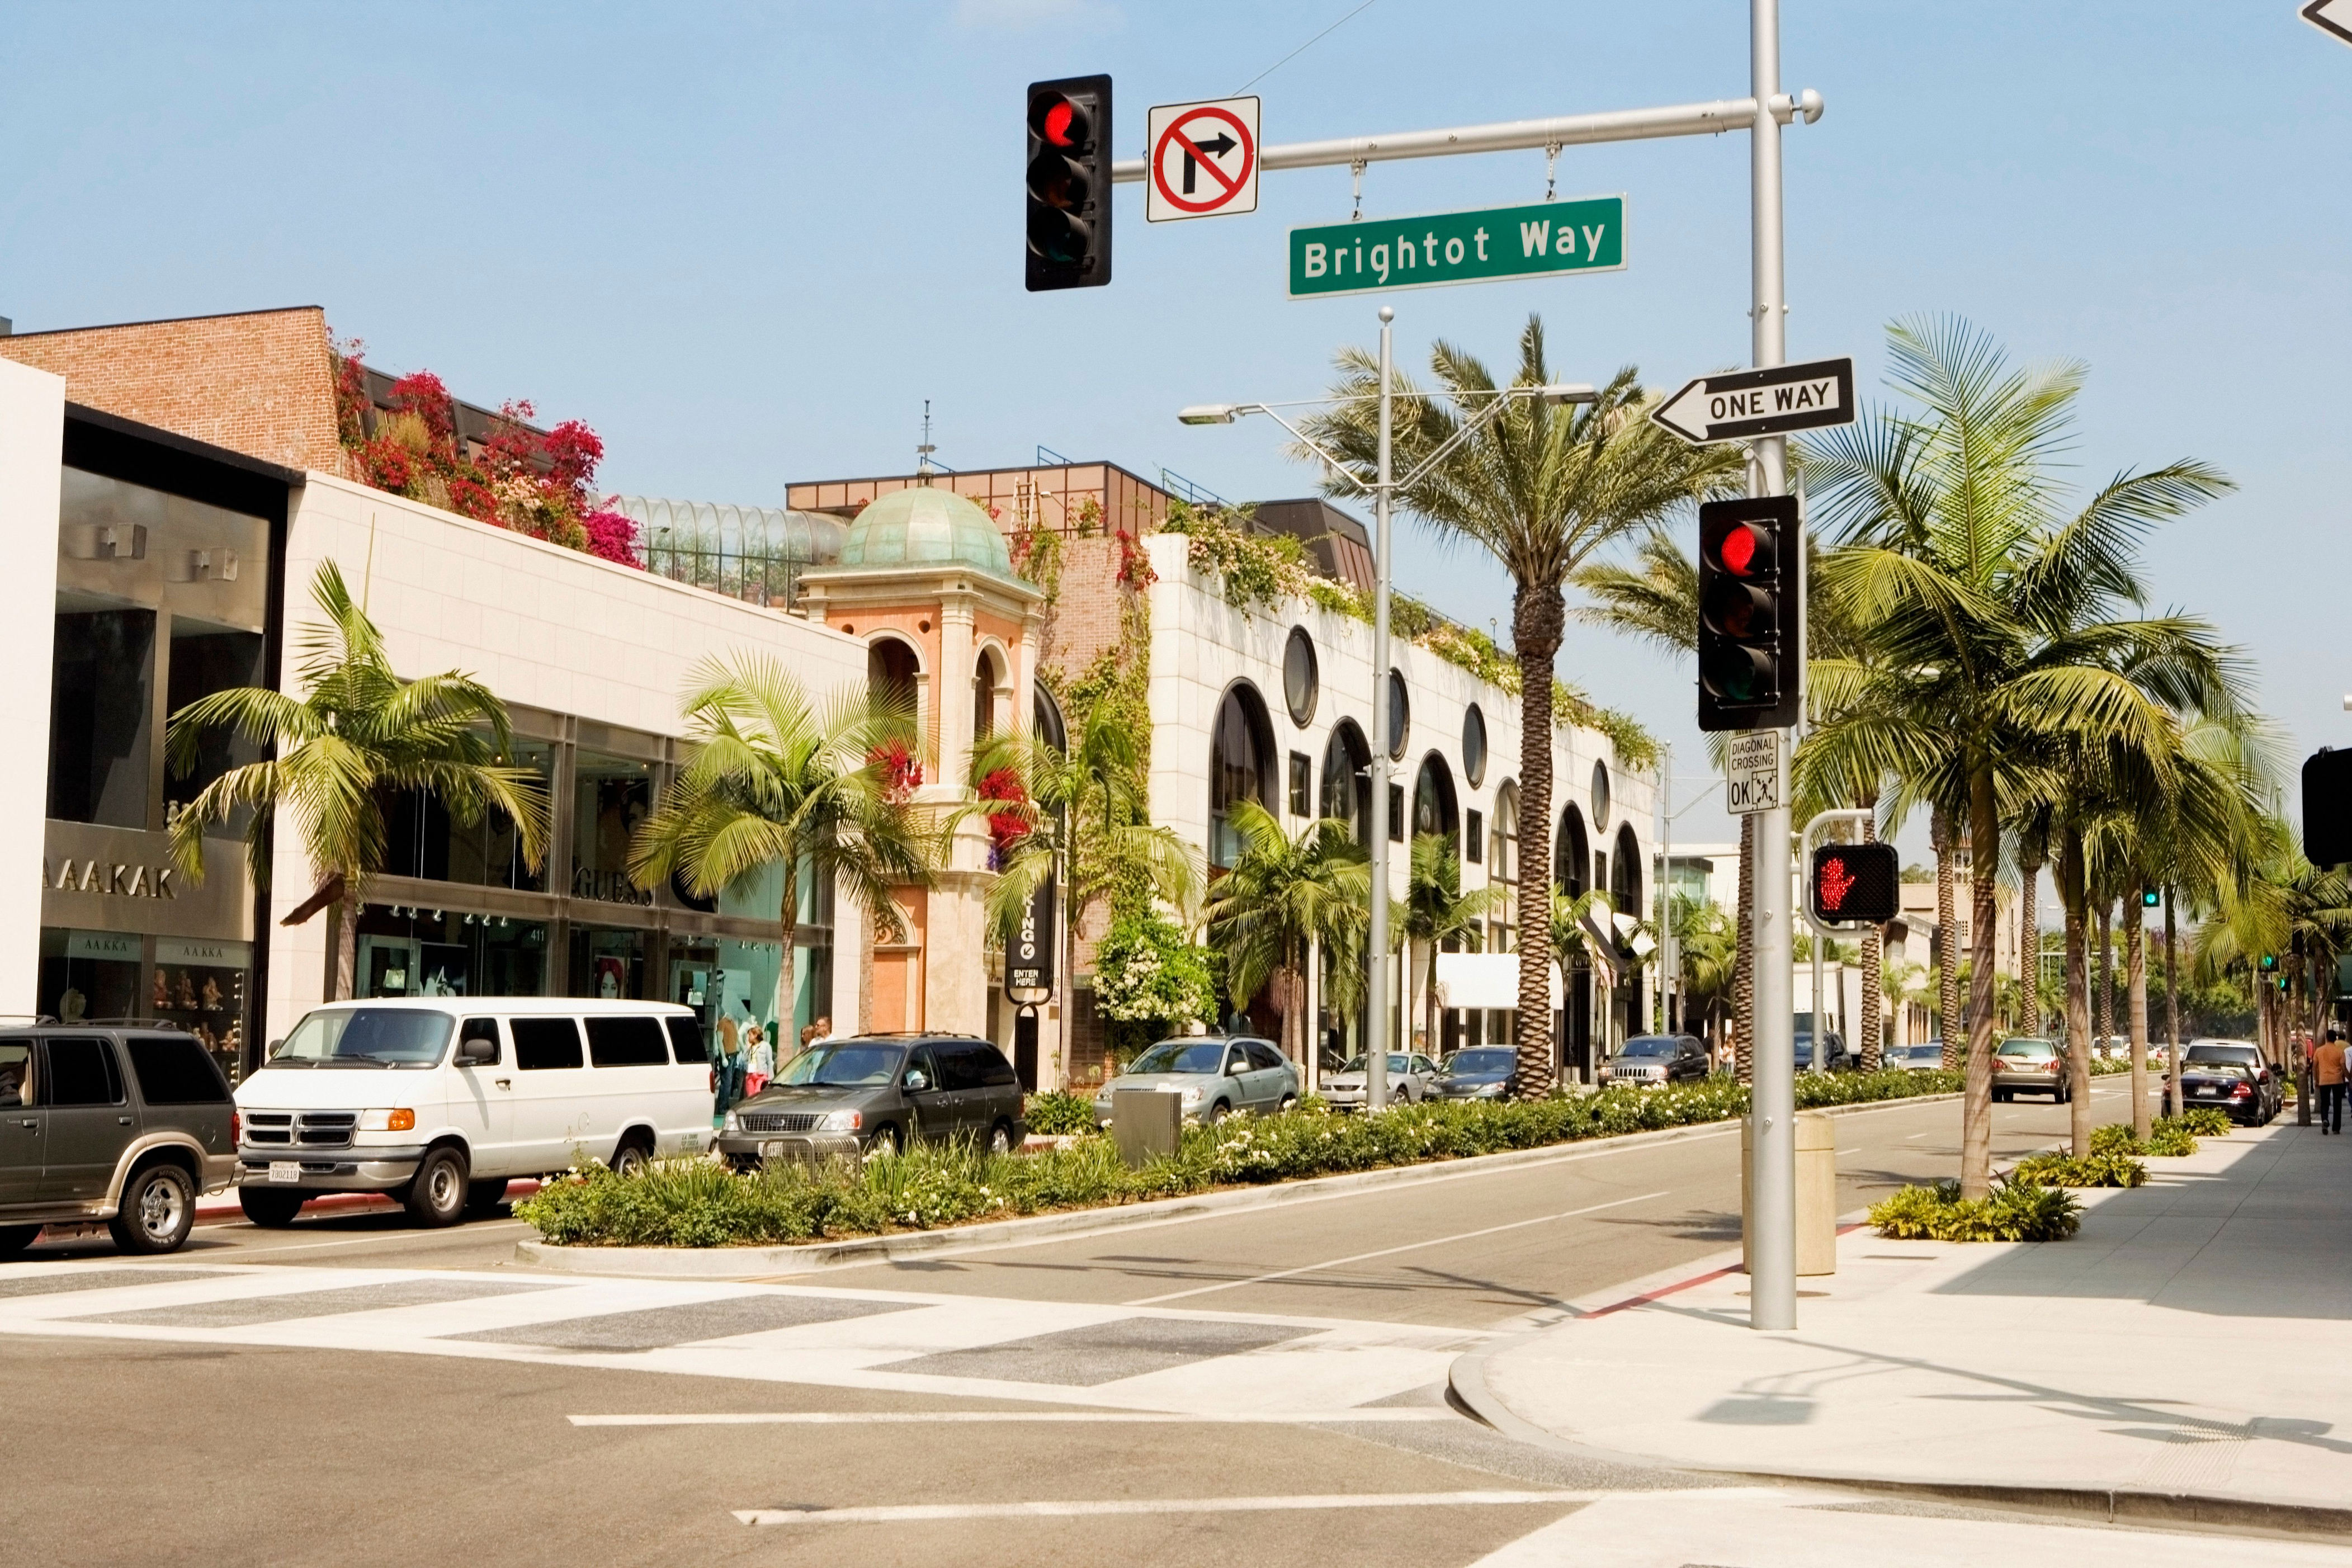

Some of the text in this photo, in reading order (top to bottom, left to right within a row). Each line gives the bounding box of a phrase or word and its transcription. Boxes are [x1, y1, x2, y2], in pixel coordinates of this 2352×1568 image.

[1305, 220, 1605, 285] Brightot Way
[1711, 382, 1830, 419] ONE WAY
[1732, 738, 1774, 755] DIAGONAL
[1732, 753, 1774, 771] CROSSING
[1731, 781, 1750, 806] OK
[531, 929, 545, 942] 411
[1016, 977, 1036, 986] HERE
